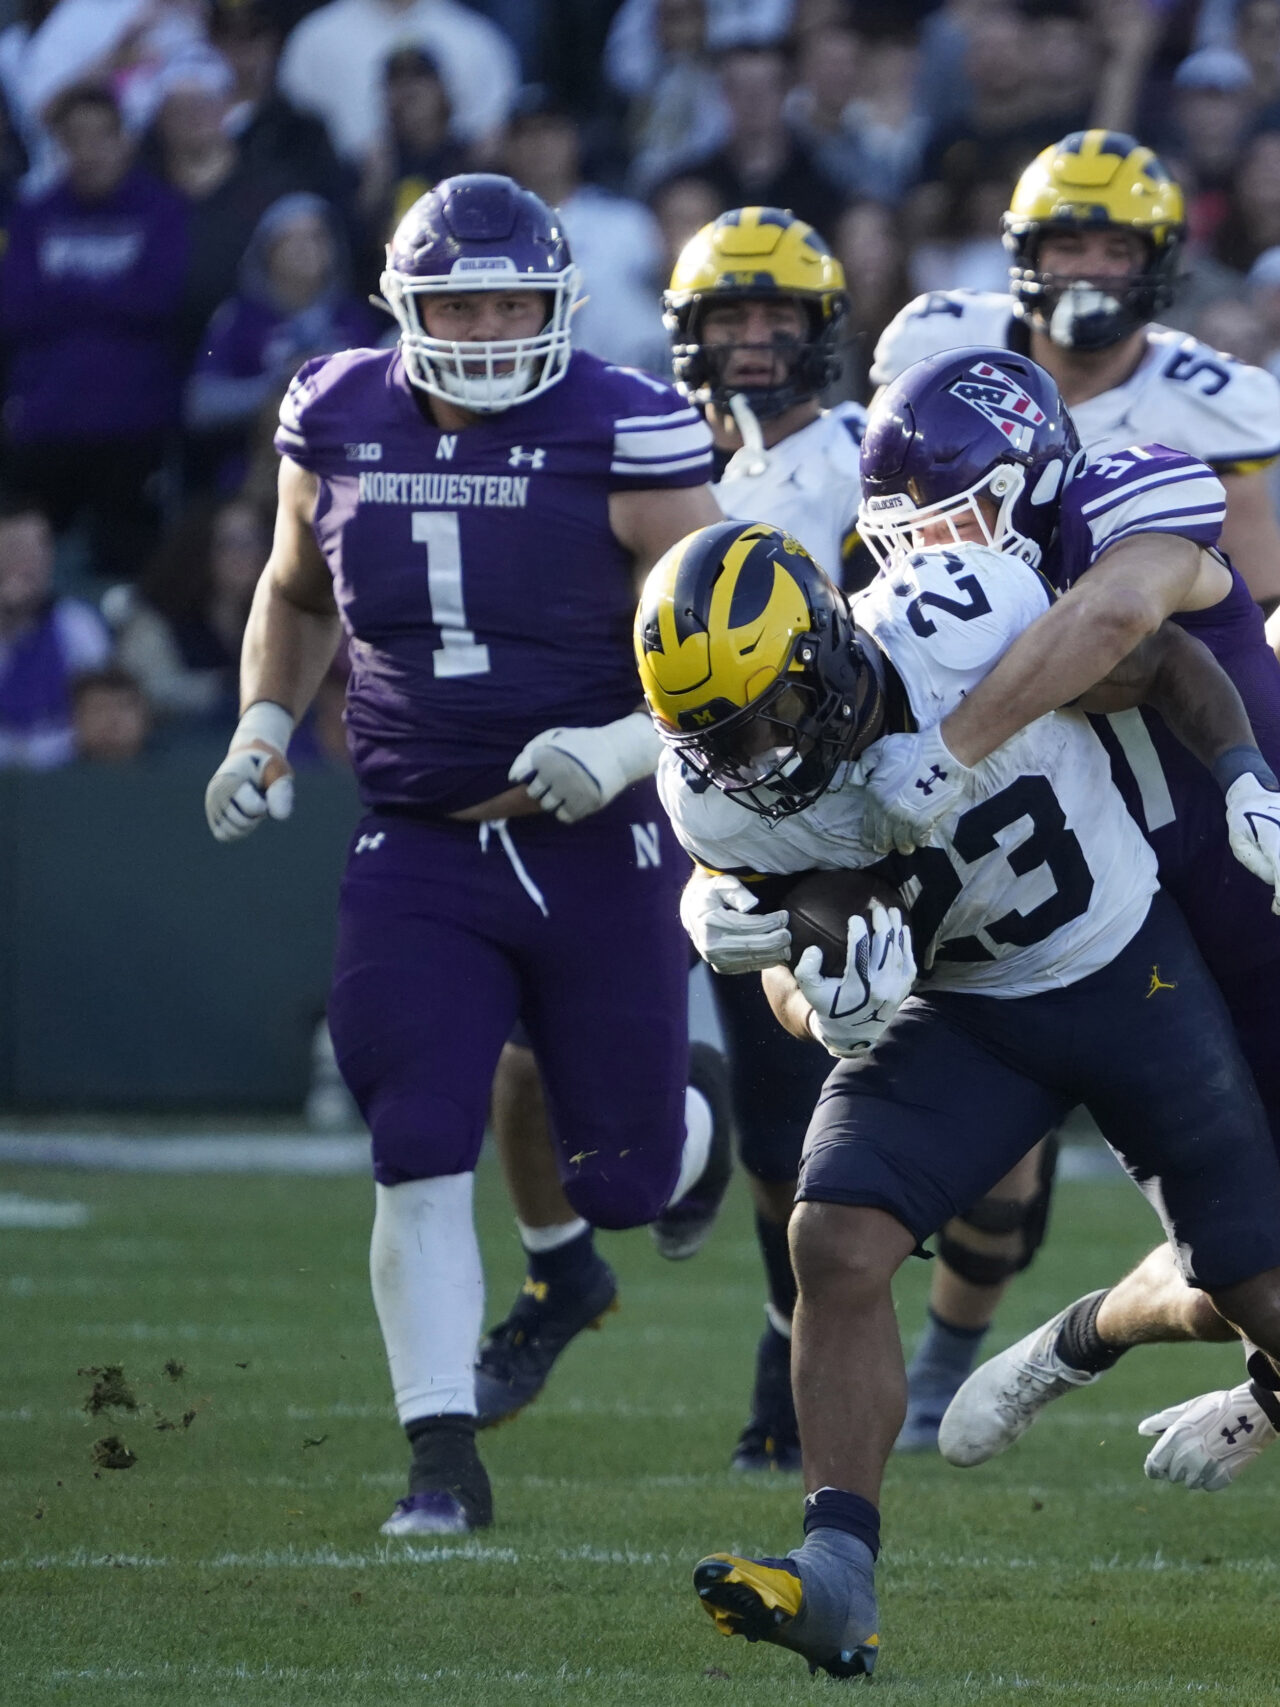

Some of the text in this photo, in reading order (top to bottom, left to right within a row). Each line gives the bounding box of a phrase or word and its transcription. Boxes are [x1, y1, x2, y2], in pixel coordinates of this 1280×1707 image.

[435, 434, 458, 460] N
[358, 471, 530, 508] NORTHWESTERN
[411, 511, 491, 678] 1
[631, 822, 661, 868] N
